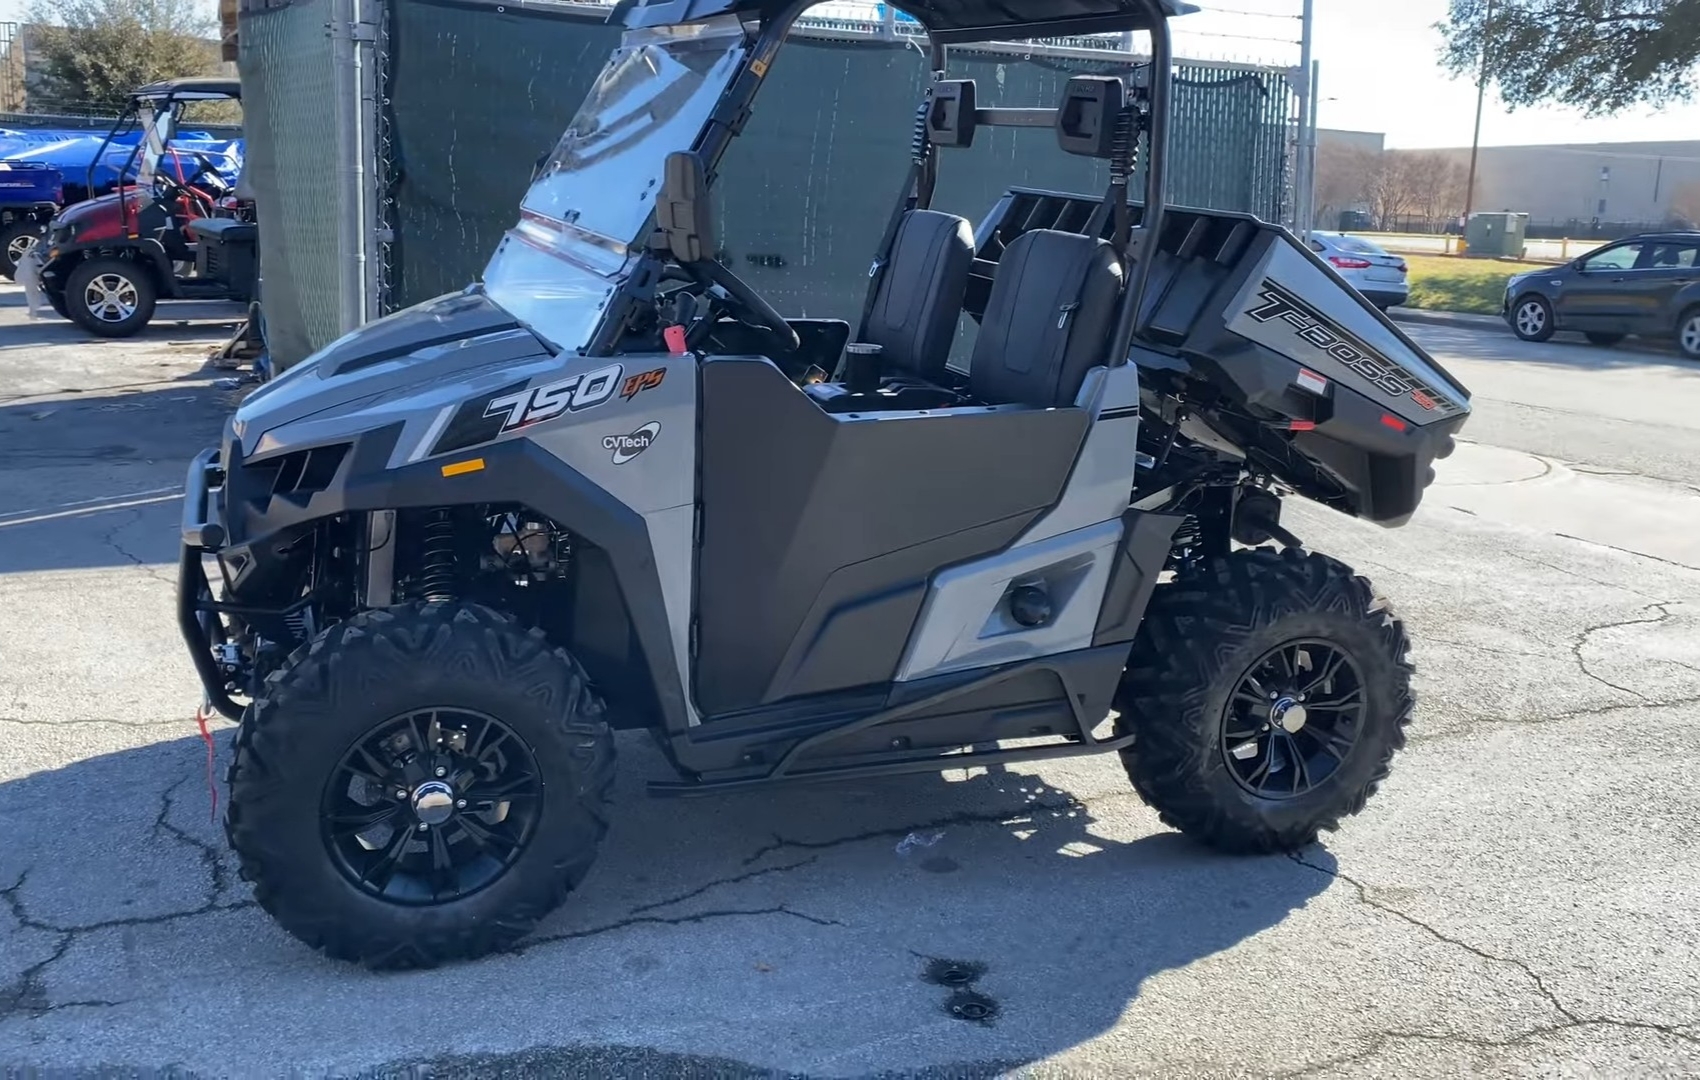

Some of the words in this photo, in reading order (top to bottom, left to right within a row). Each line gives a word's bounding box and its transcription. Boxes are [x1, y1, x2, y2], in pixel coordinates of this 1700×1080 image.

[1245, 290, 1413, 397] T-BOSS
[482, 363, 625, 435] 750
[619, 367, 667, 402] EPS
[602, 435, 650, 449] CVTech
